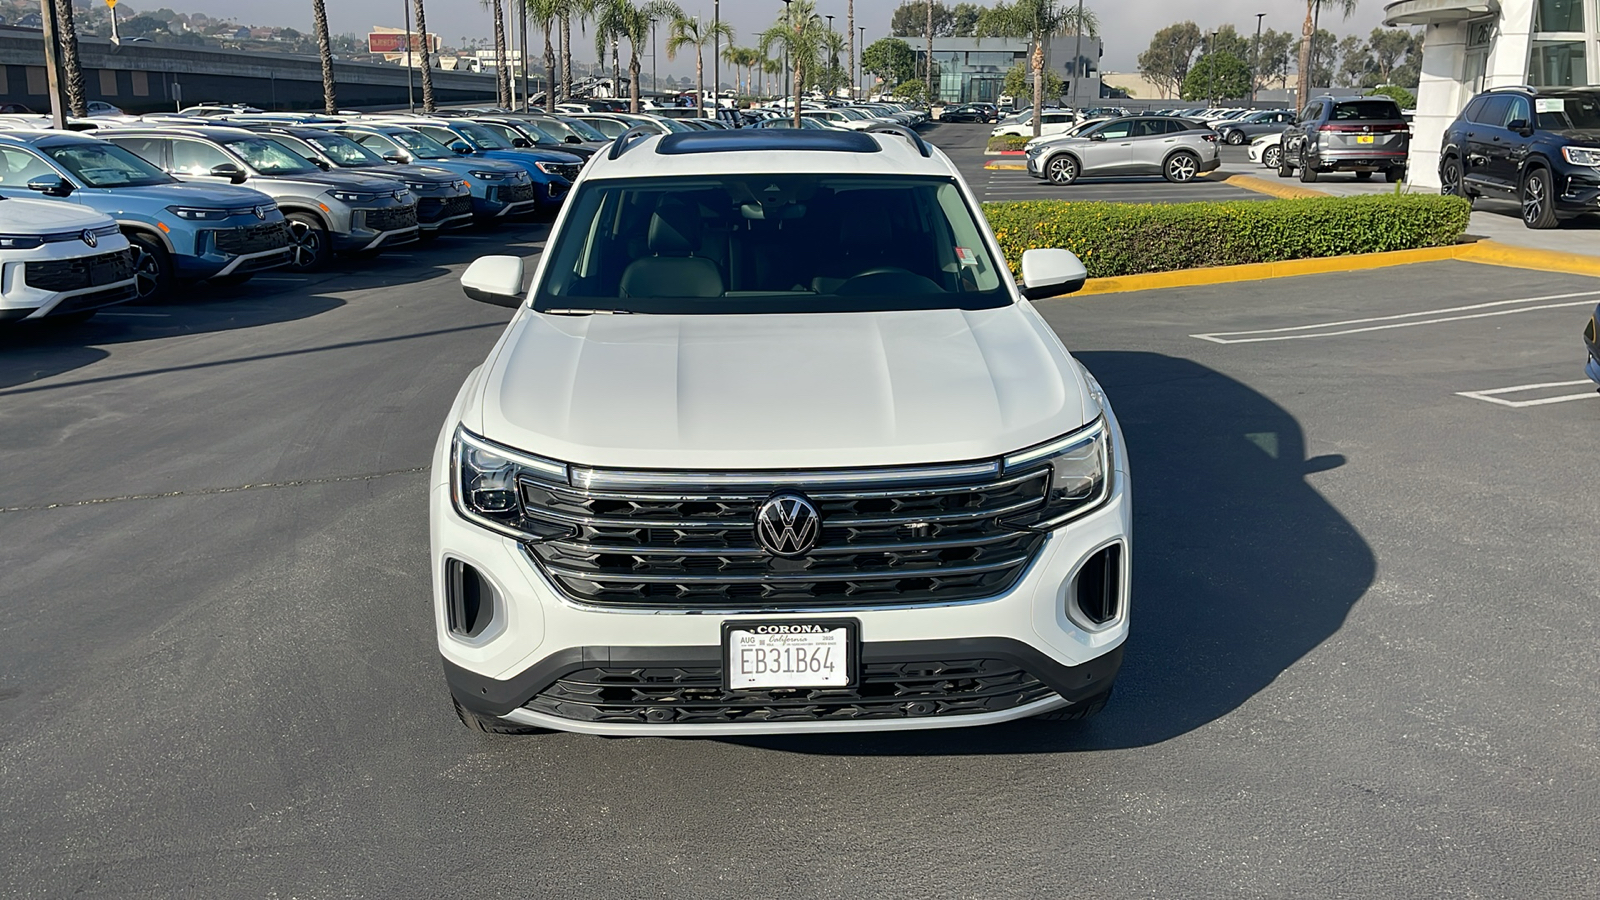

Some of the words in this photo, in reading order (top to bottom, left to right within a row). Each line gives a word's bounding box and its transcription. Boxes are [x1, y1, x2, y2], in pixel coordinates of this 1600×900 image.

[759, 497, 817, 554] VW
[757, 625, 823, 634] CORONA
[740, 636, 756, 644] AUG
[768, 635, 808, 646] California
[741, 647, 835, 674] EB31B64
